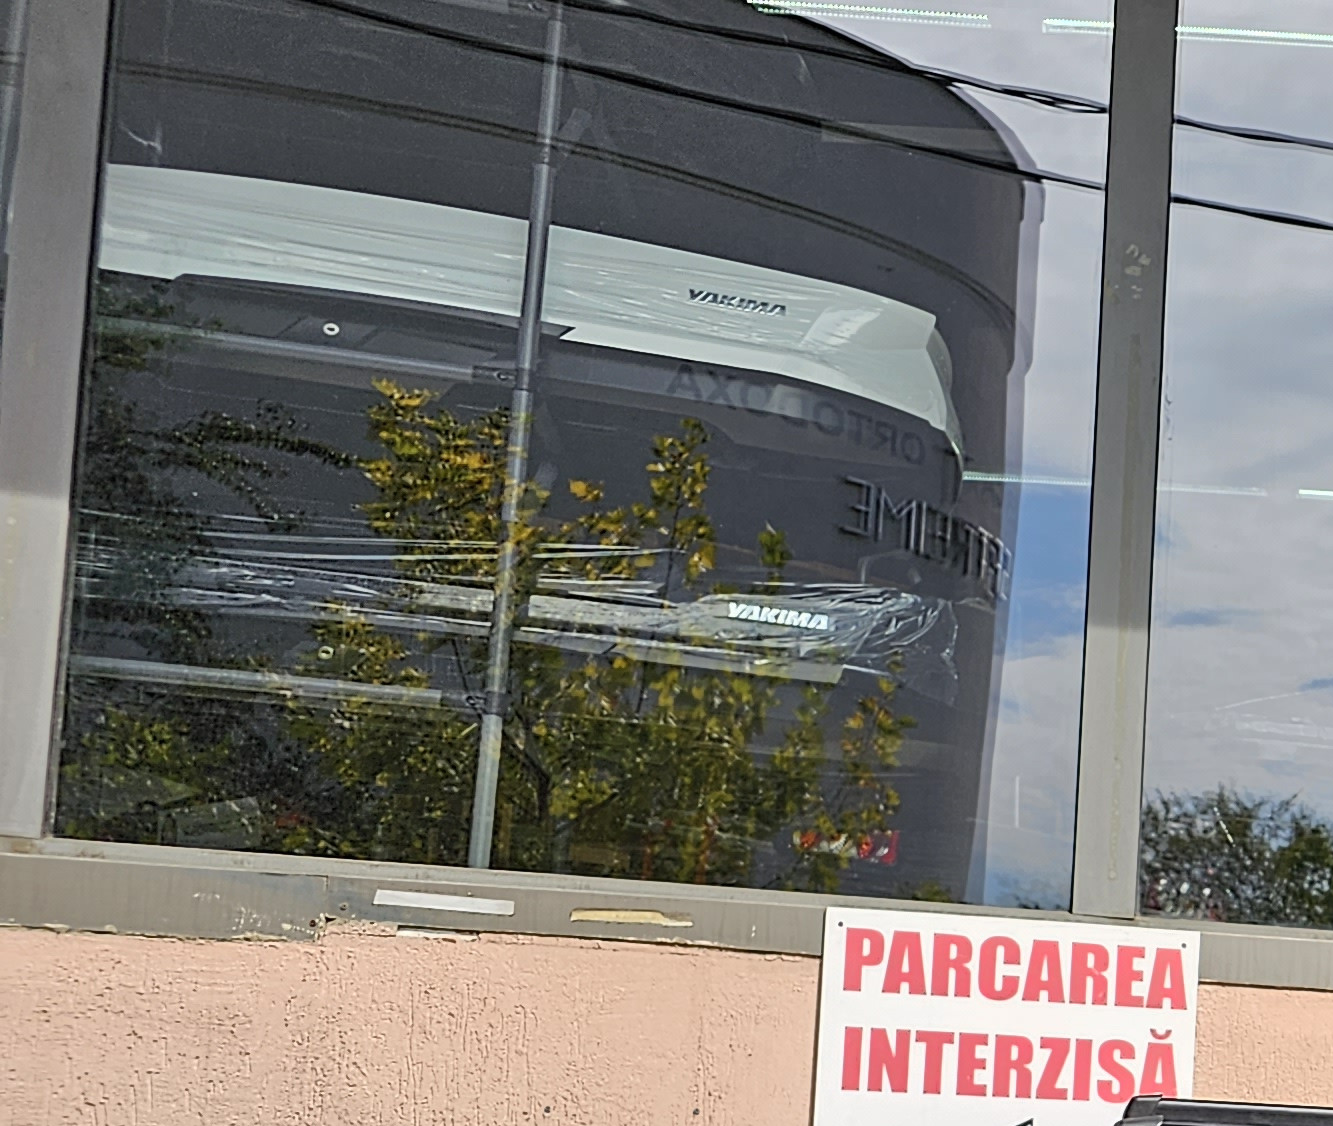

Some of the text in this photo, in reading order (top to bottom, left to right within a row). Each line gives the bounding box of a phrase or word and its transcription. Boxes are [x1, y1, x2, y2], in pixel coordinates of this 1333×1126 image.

[688, 288, 787, 317] YAKIMA
[727, 601, 831, 631] YAKIMA
[842, 926, 1188, 1010] PARCAREA
[841, 1025, 1178, 1104] INTERZISĂ
